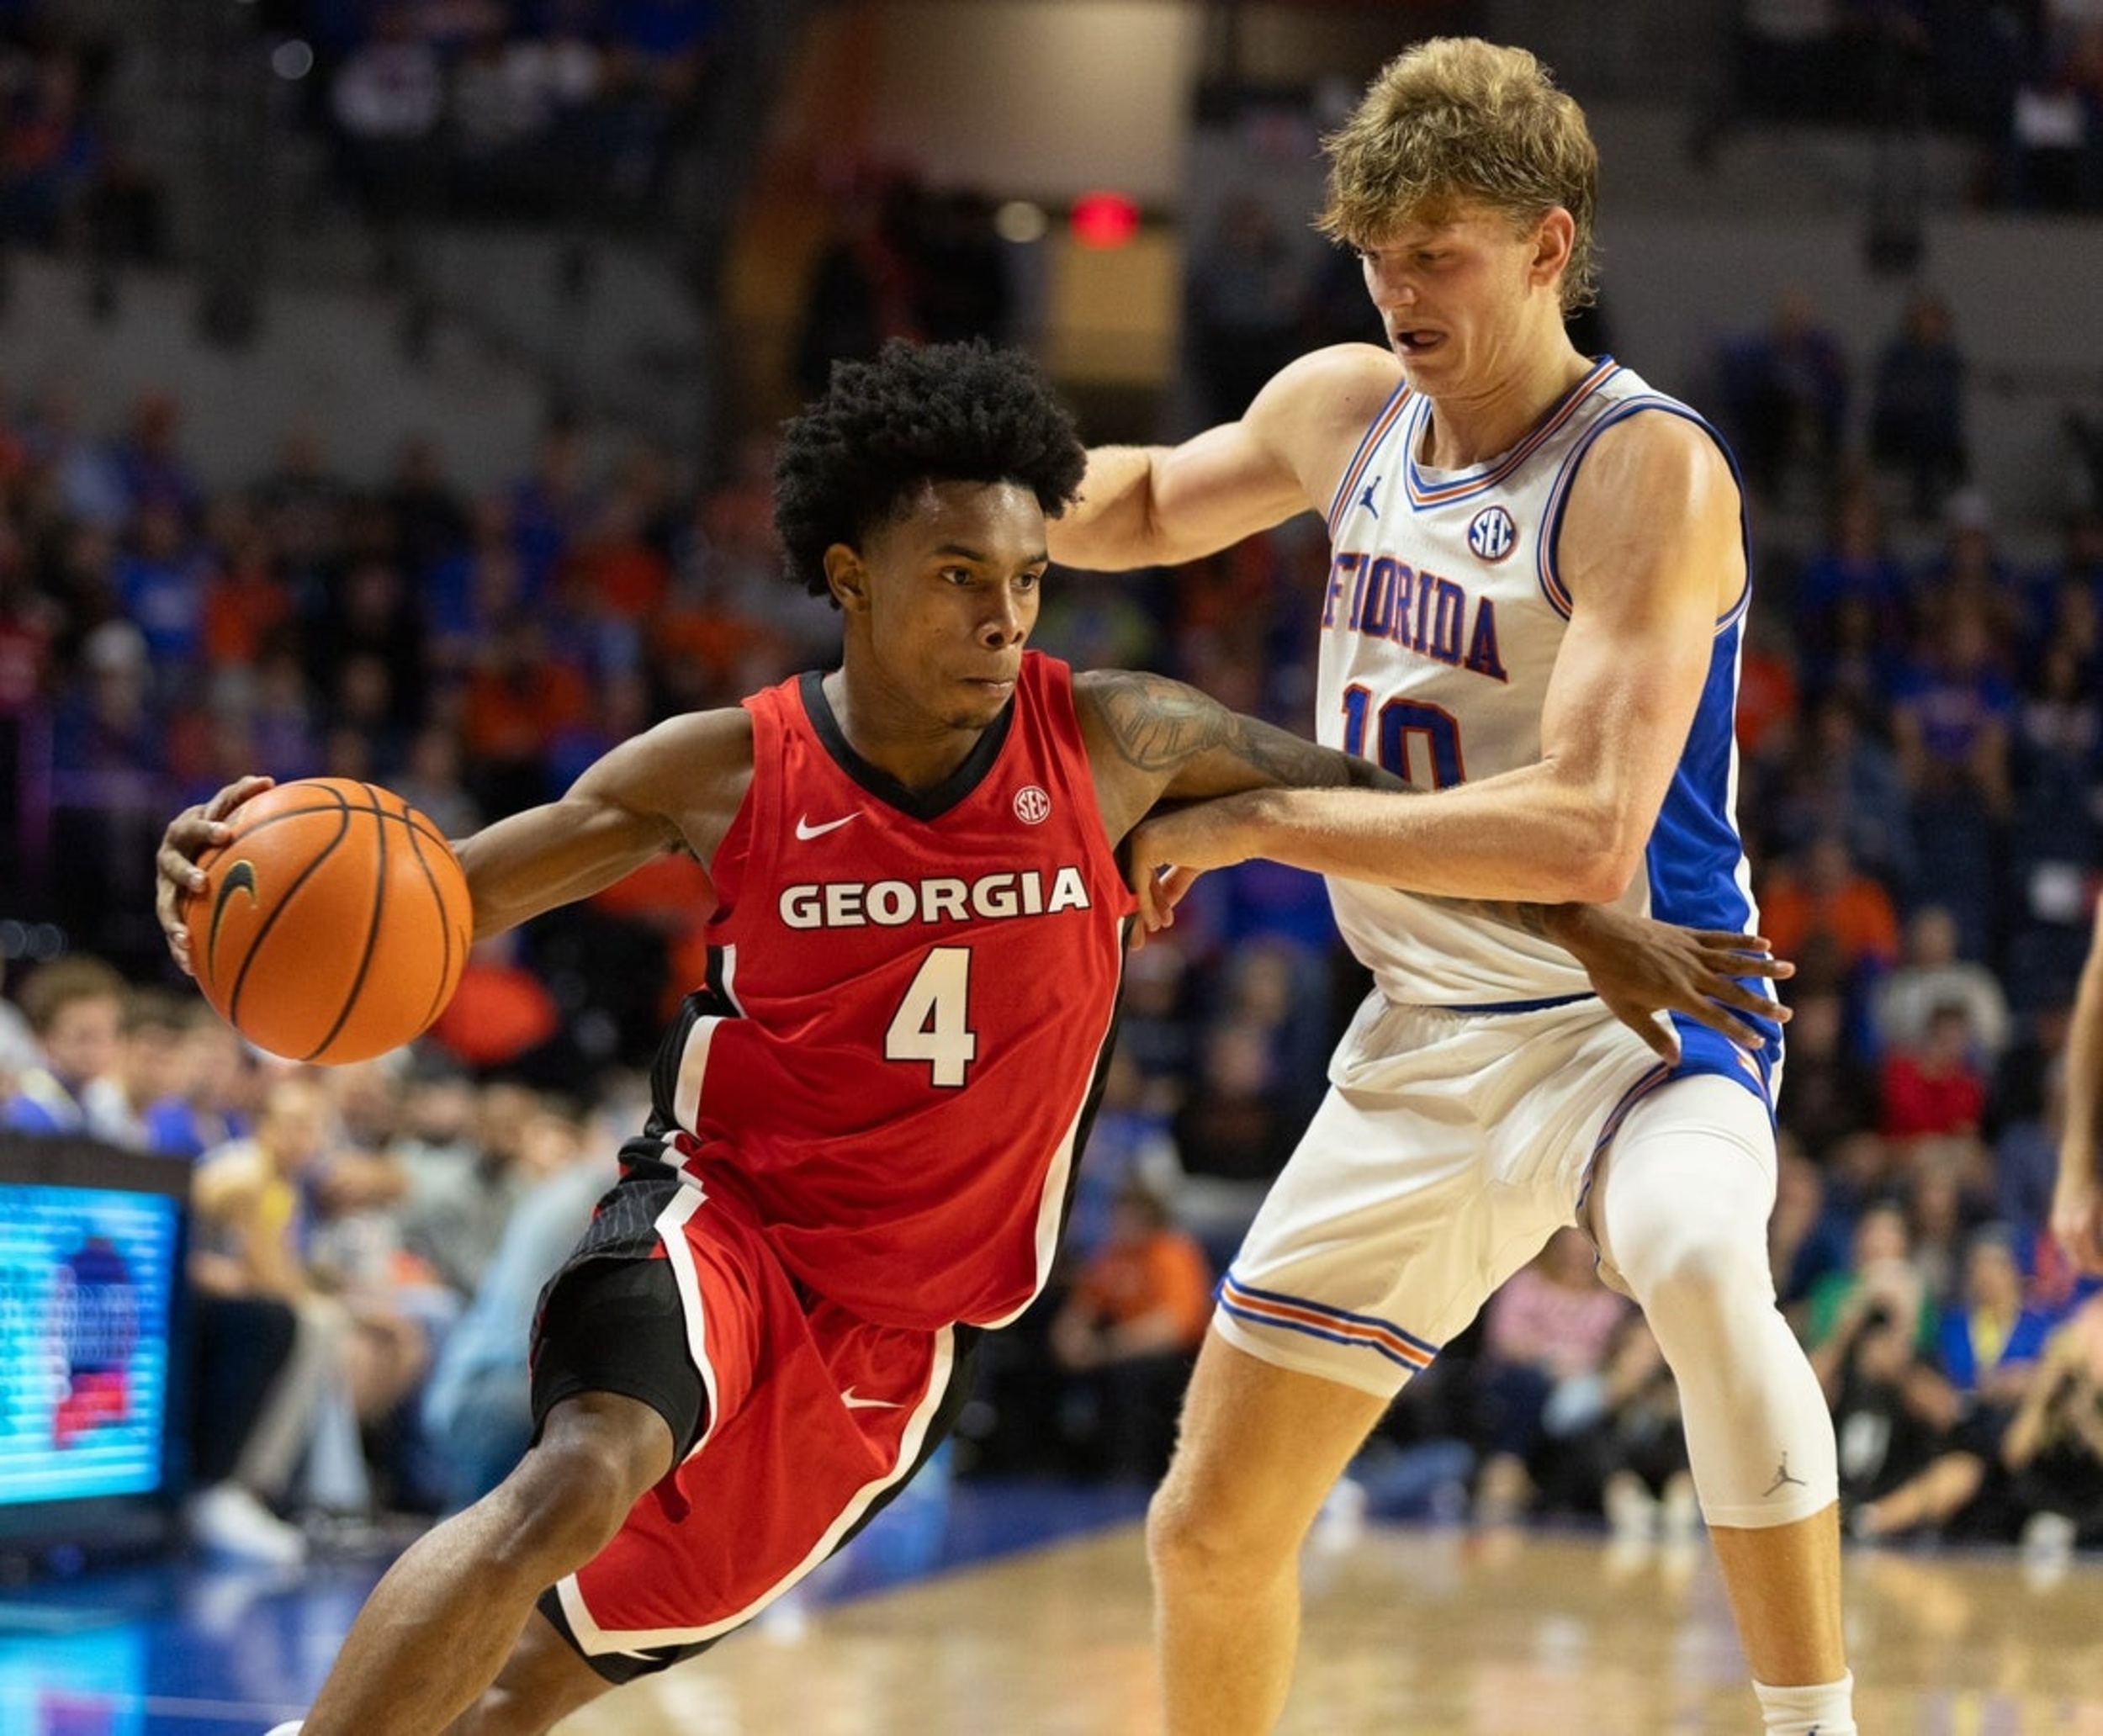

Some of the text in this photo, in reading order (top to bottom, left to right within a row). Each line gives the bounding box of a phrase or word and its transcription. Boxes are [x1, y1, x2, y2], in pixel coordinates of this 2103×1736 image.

[1470, 506, 1513, 558] SEC
[1018, 791, 1047, 821] SEC
[778, 866, 1092, 930] GEORGIA
[883, 945, 977, 1089] 4
